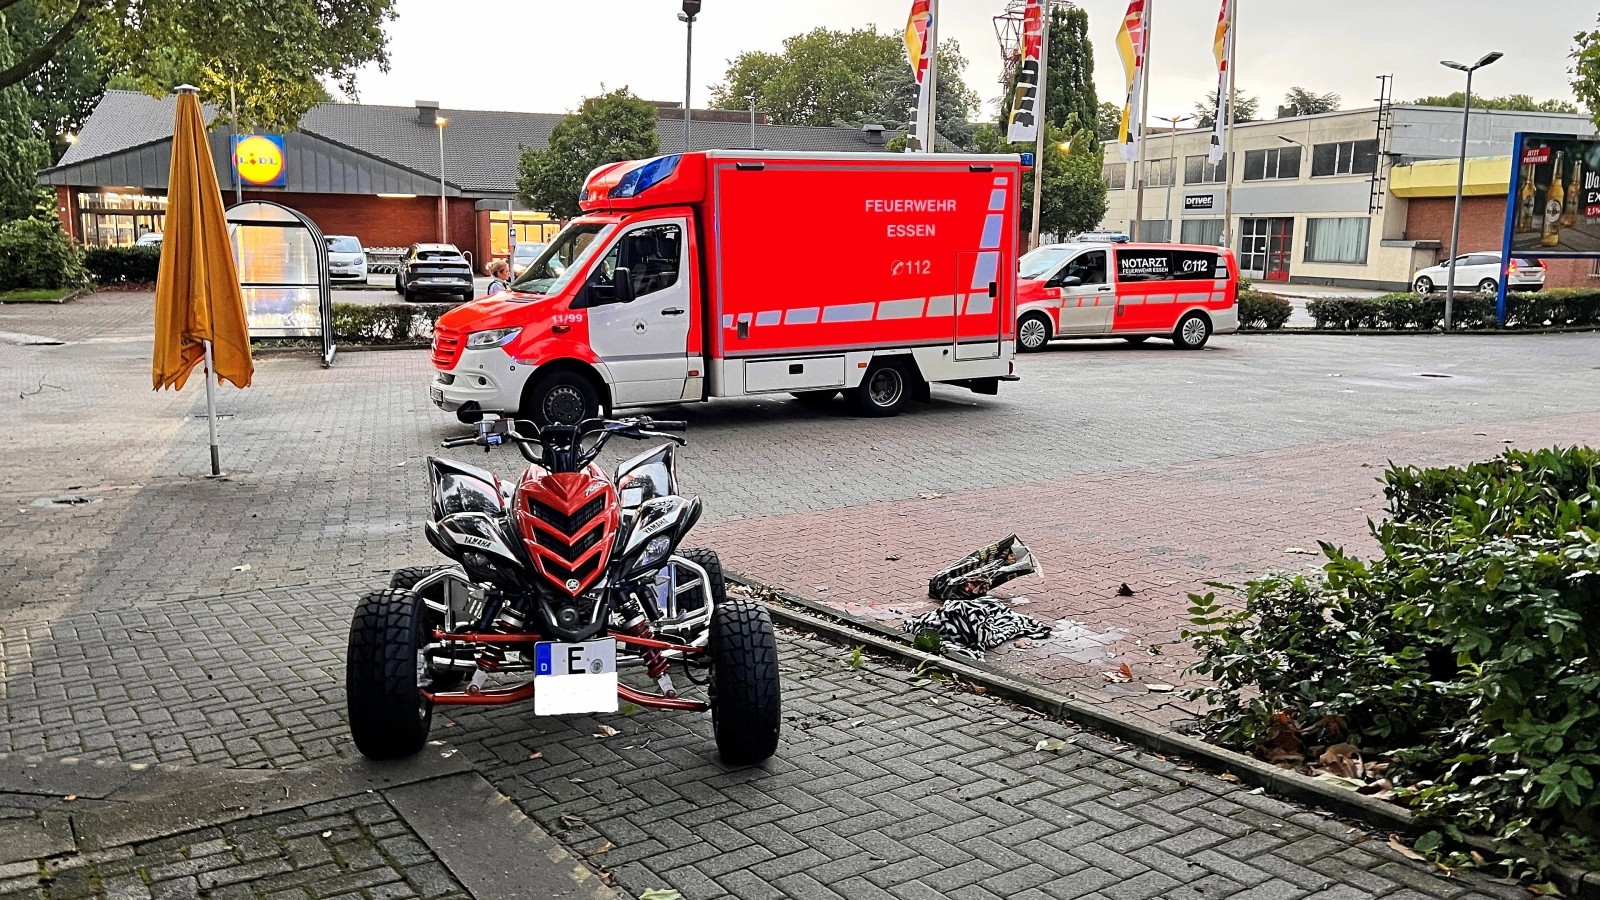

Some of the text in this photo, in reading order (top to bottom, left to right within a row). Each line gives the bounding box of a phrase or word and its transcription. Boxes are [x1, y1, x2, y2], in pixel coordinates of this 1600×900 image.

[865, 199, 957, 212] FEUERWEHR
[887, 224, 936, 237] ESSEN
[905, 260, 931, 275] 112
[1121, 257, 1168, 268] NOTARZT
[1192, 260, 1208, 272] 112
[552, 313, 583, 324] 11/99
[643, 517, 670, 534] YAMAHA
[464, 536, 492, 549] YAMAHA
[567, 646, 586, 675] E
[540, 663, 548, 672] D
